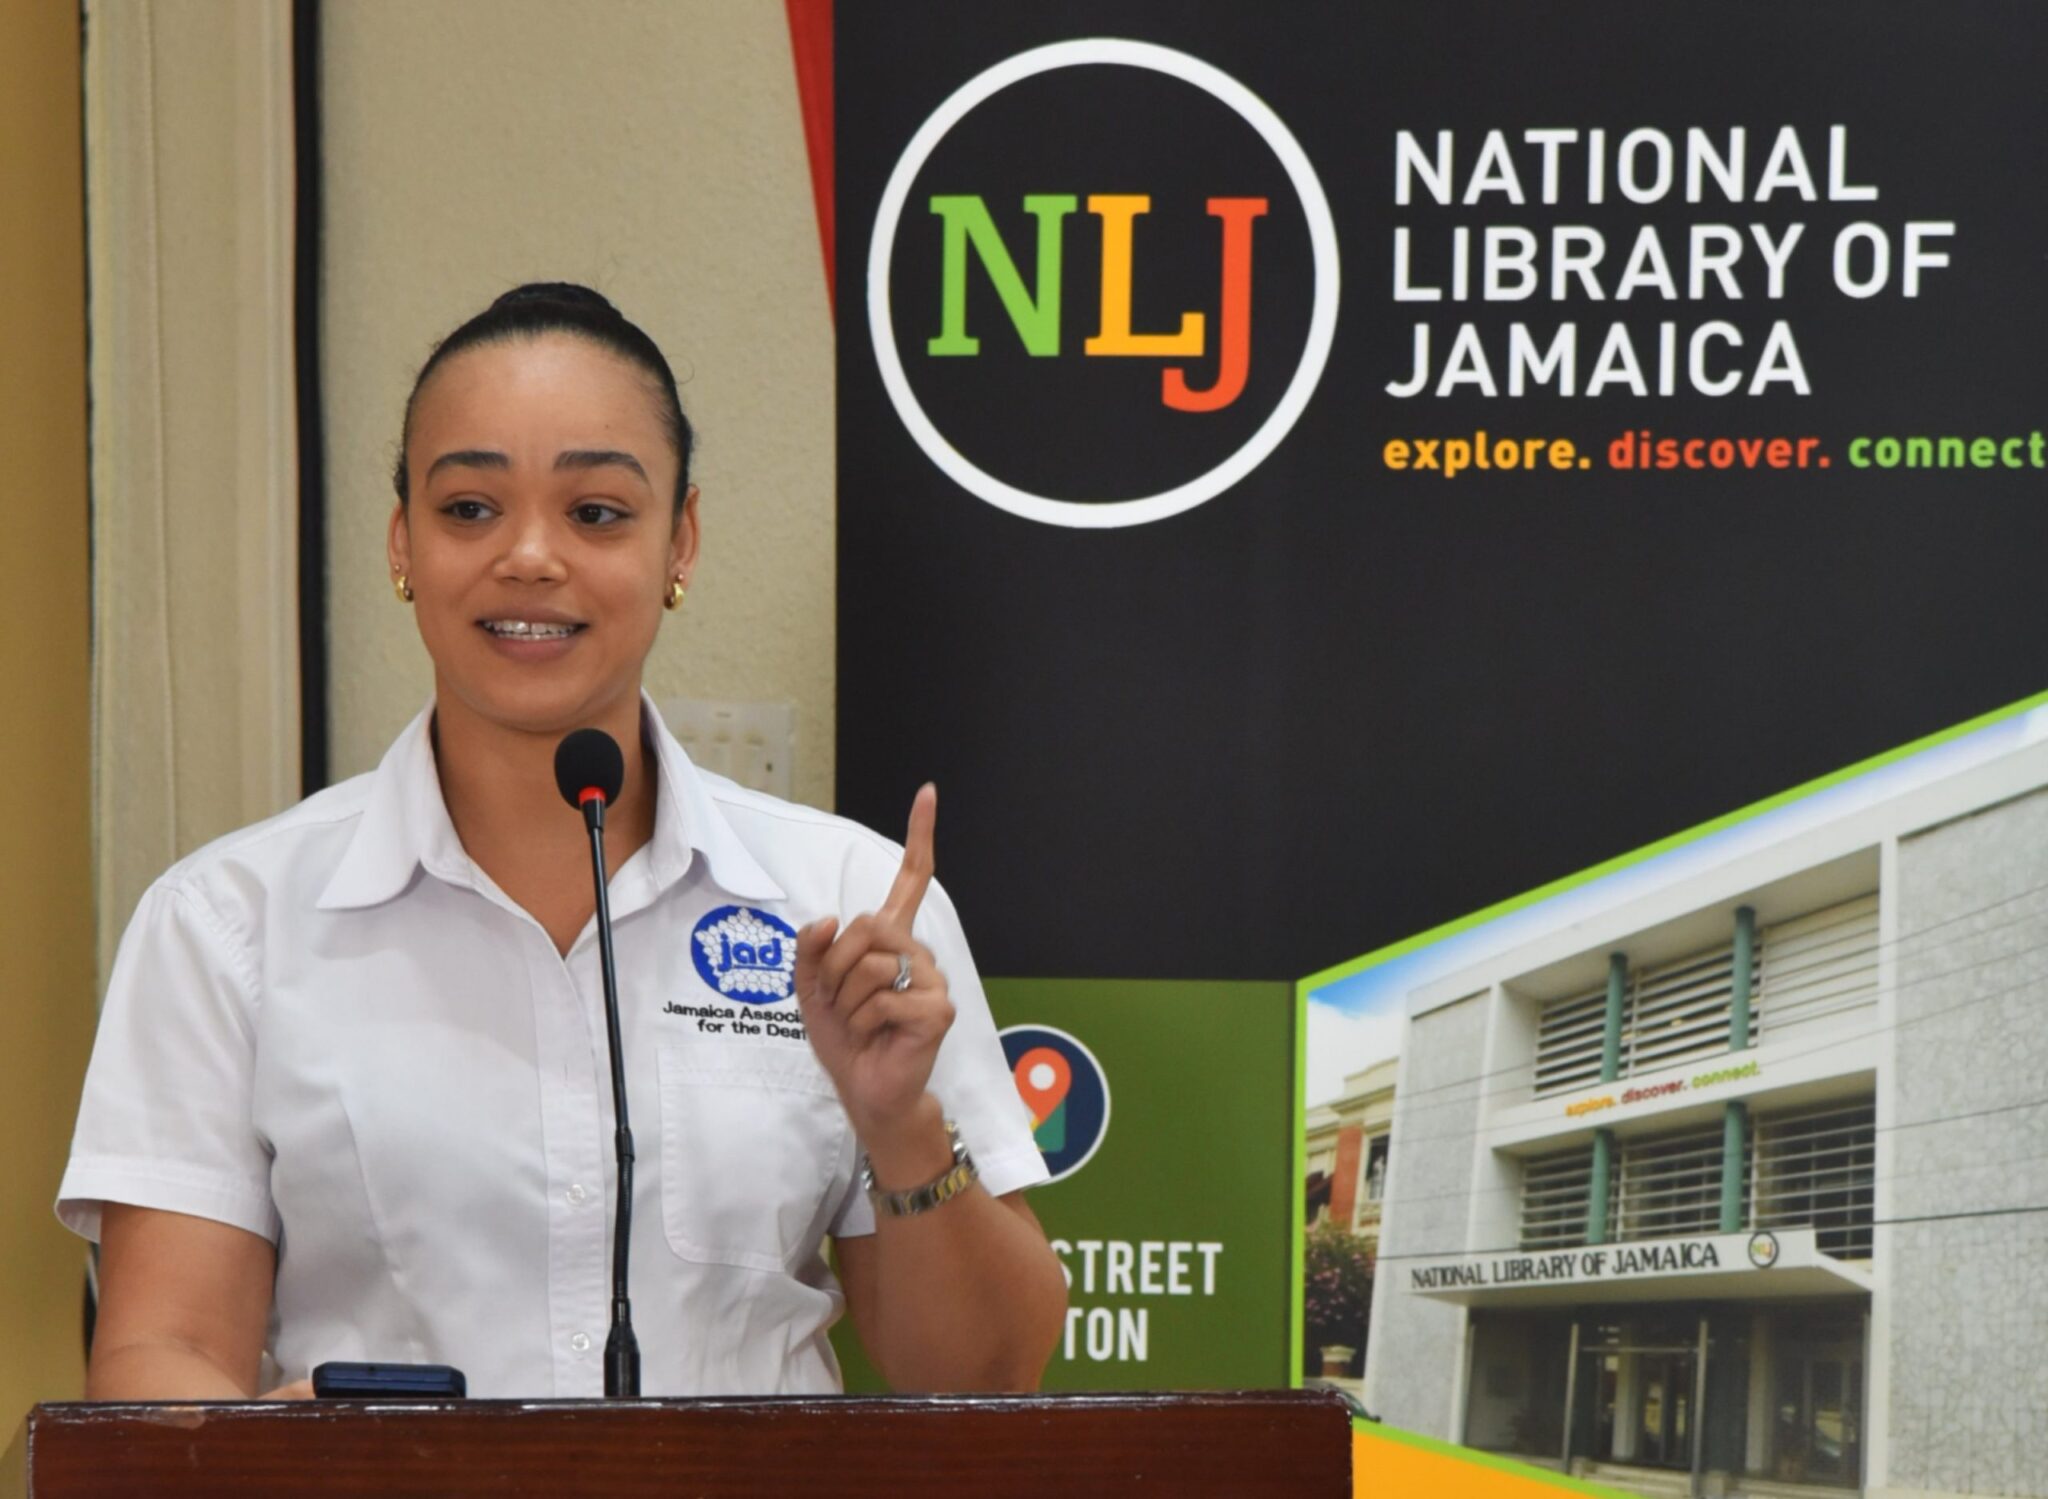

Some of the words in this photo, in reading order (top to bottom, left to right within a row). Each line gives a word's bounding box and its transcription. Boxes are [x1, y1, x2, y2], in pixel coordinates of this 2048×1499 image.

[1396, 125, 1879, 205] NATIONAL
[1393, 224, 1805, 301] LIBRARY
[1832, 222, 1956, 298] OF
[928, 194, 1269, 413] NLJ
[1385, 320, 1811, 398] JAMAICA
[1383, 430, 1591, 478] explore.
[1608, 430, 1830, 468] discover.
[1848, 432, 2046, 469] connect
[716, 932, 782, 973] jad
[663, 1001, 735, 1019] Jamaica
[740, 1006, 804, 1024] Associ
[697, 1018, 725, 1033] for
[732, 1020, 761, 1035] the
[1411, 1263, 1488, 1289] NATIONAL
[1493, 1253, 1577, 1284] LIBRARY
[1581, 1251, 1608, 1276] OF
[1612, 1242, 1720, 1275] JAMAICA
